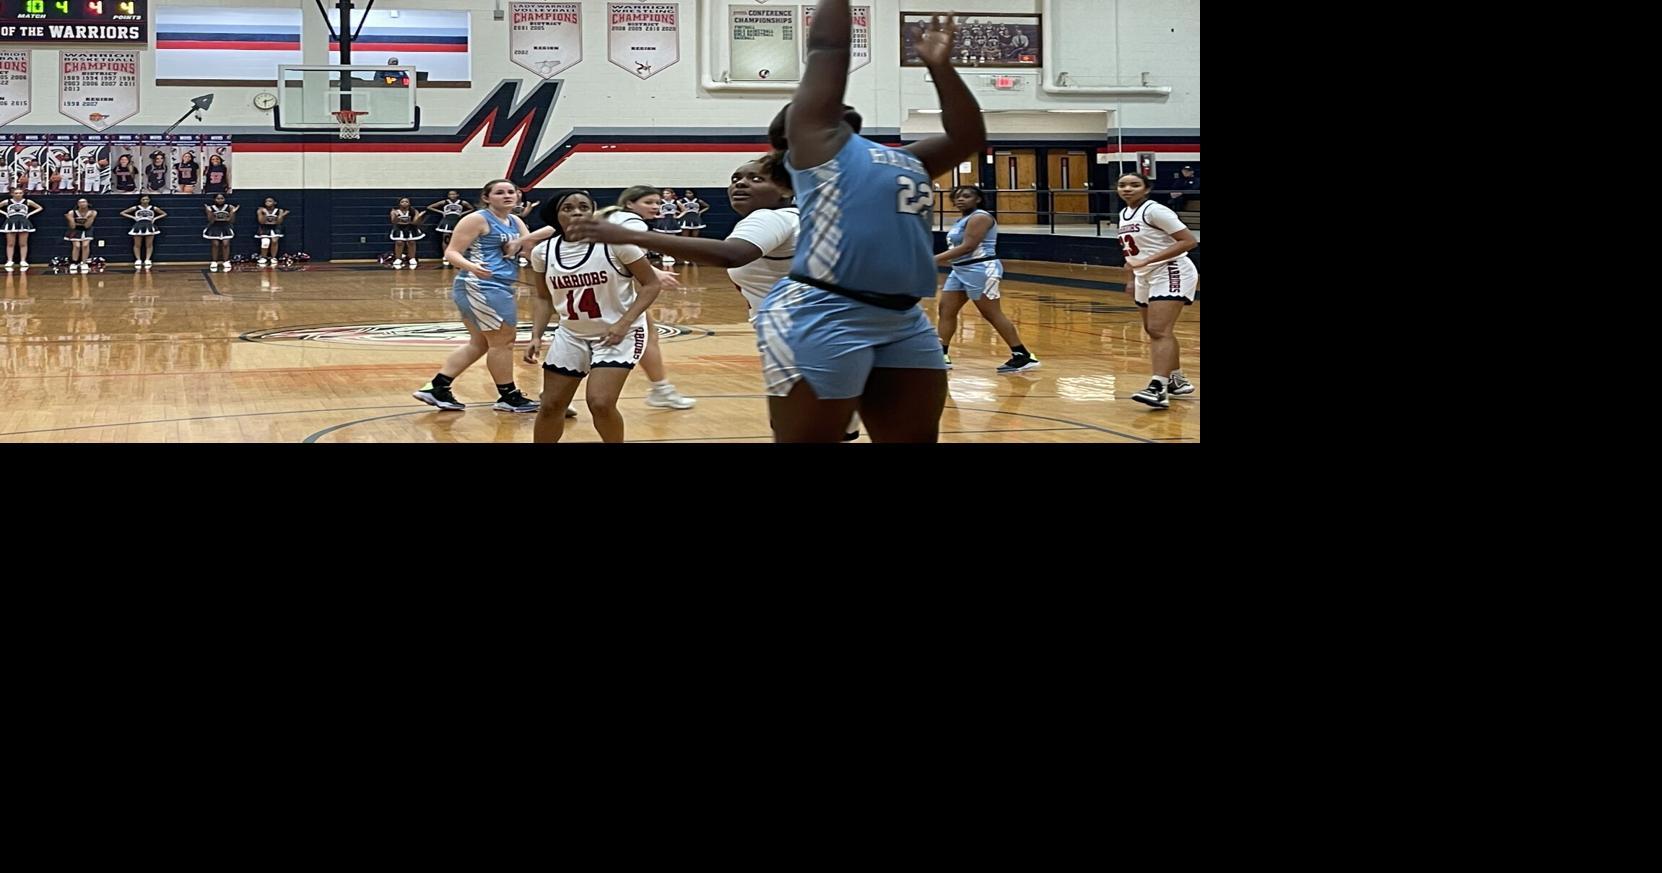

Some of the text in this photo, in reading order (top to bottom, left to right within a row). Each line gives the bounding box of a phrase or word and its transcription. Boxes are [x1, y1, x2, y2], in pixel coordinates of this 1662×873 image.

[55, 1, 68, 13] 4
[88, 1, 102, 14] 4
[119, 1, 134, 14] 4
[513, 13, 578, 25] CHAMPIONS
[612, 14, 675, 25] CHAMPIONS
[1, 25, 140, 39] OF THE WARRIORS
[64, 62, 135, 74] CHAMPIONS
[566, 288, 602, 320] 14
